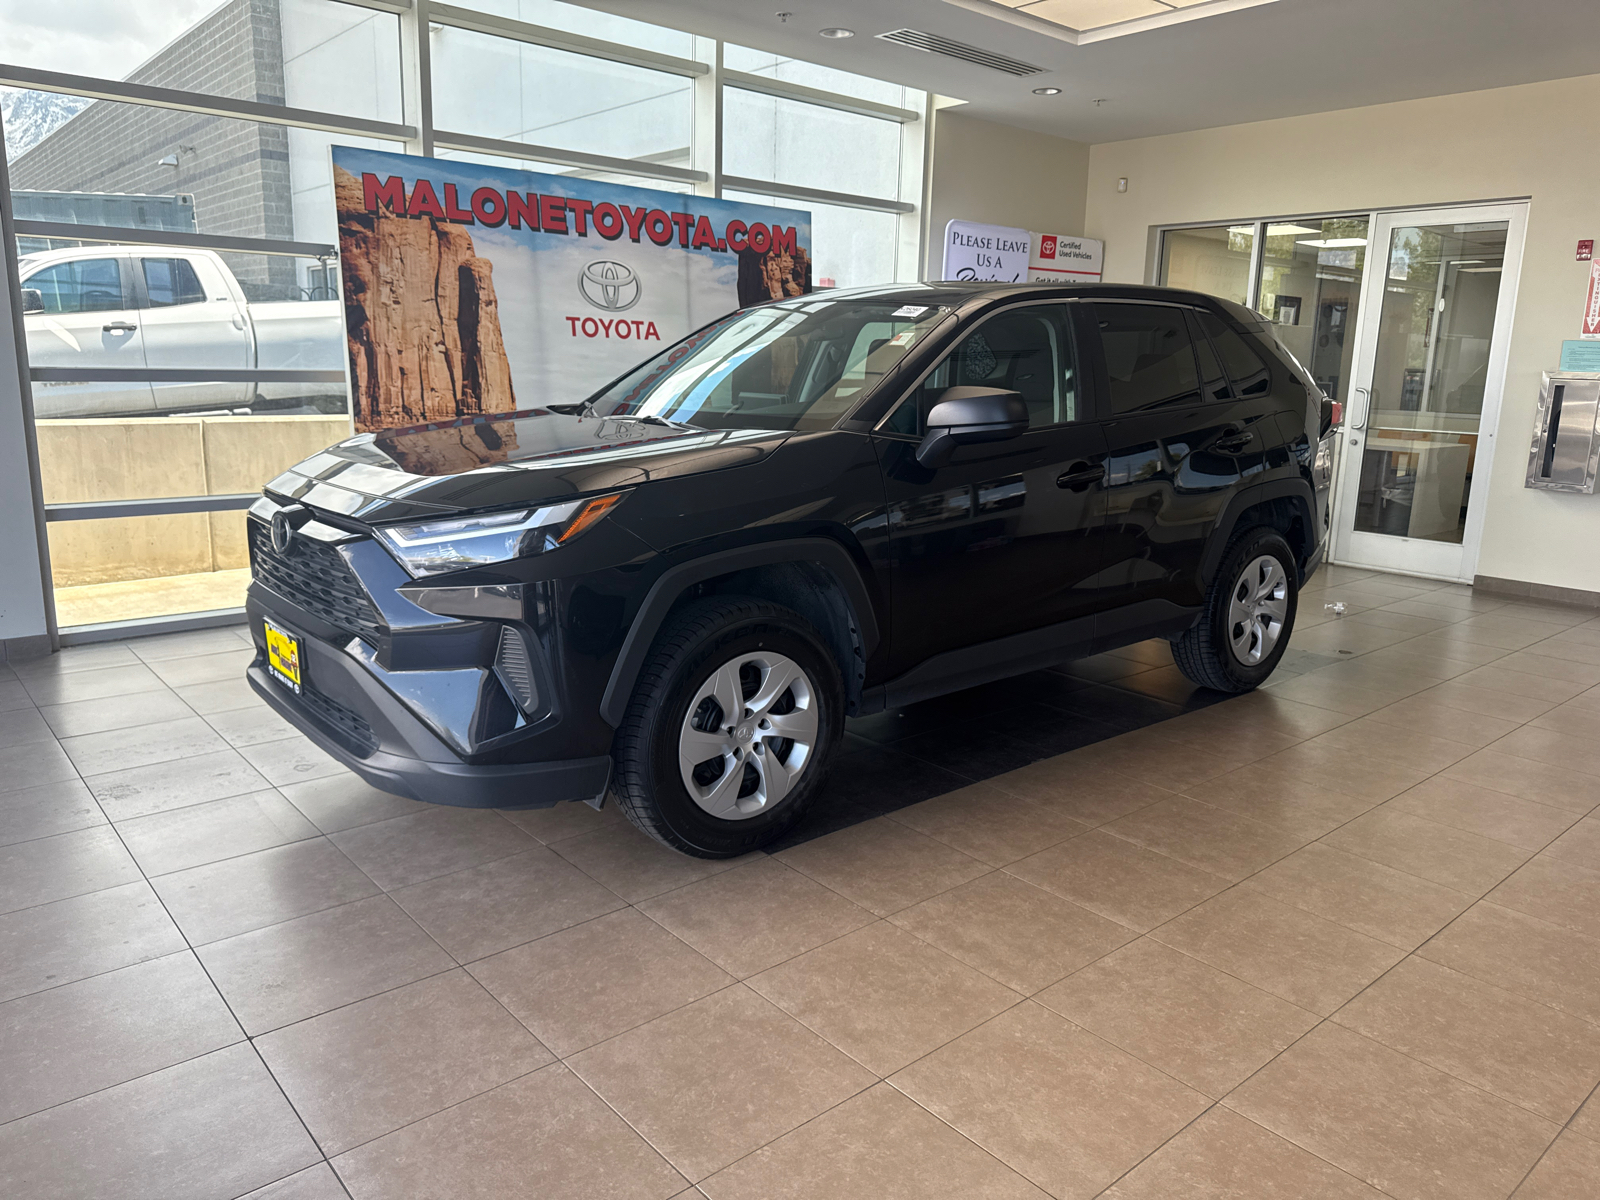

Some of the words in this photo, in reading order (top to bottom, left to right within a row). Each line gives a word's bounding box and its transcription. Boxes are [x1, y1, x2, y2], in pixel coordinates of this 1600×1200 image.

[361, 172, 798, 256] MALONETOYOTA.COM
[952, 231, 992, 249] PLEASE
[996, 238, 1028, 253] LEAVE
[1060, 241, 1082, 250] Certified
[994, 256, 1002, 268] A
[1059, 250, 1072, 258] Used
[1073, 251, 1092, 260] Vehicles
[565, 316, 661, 341] TOYOTA
